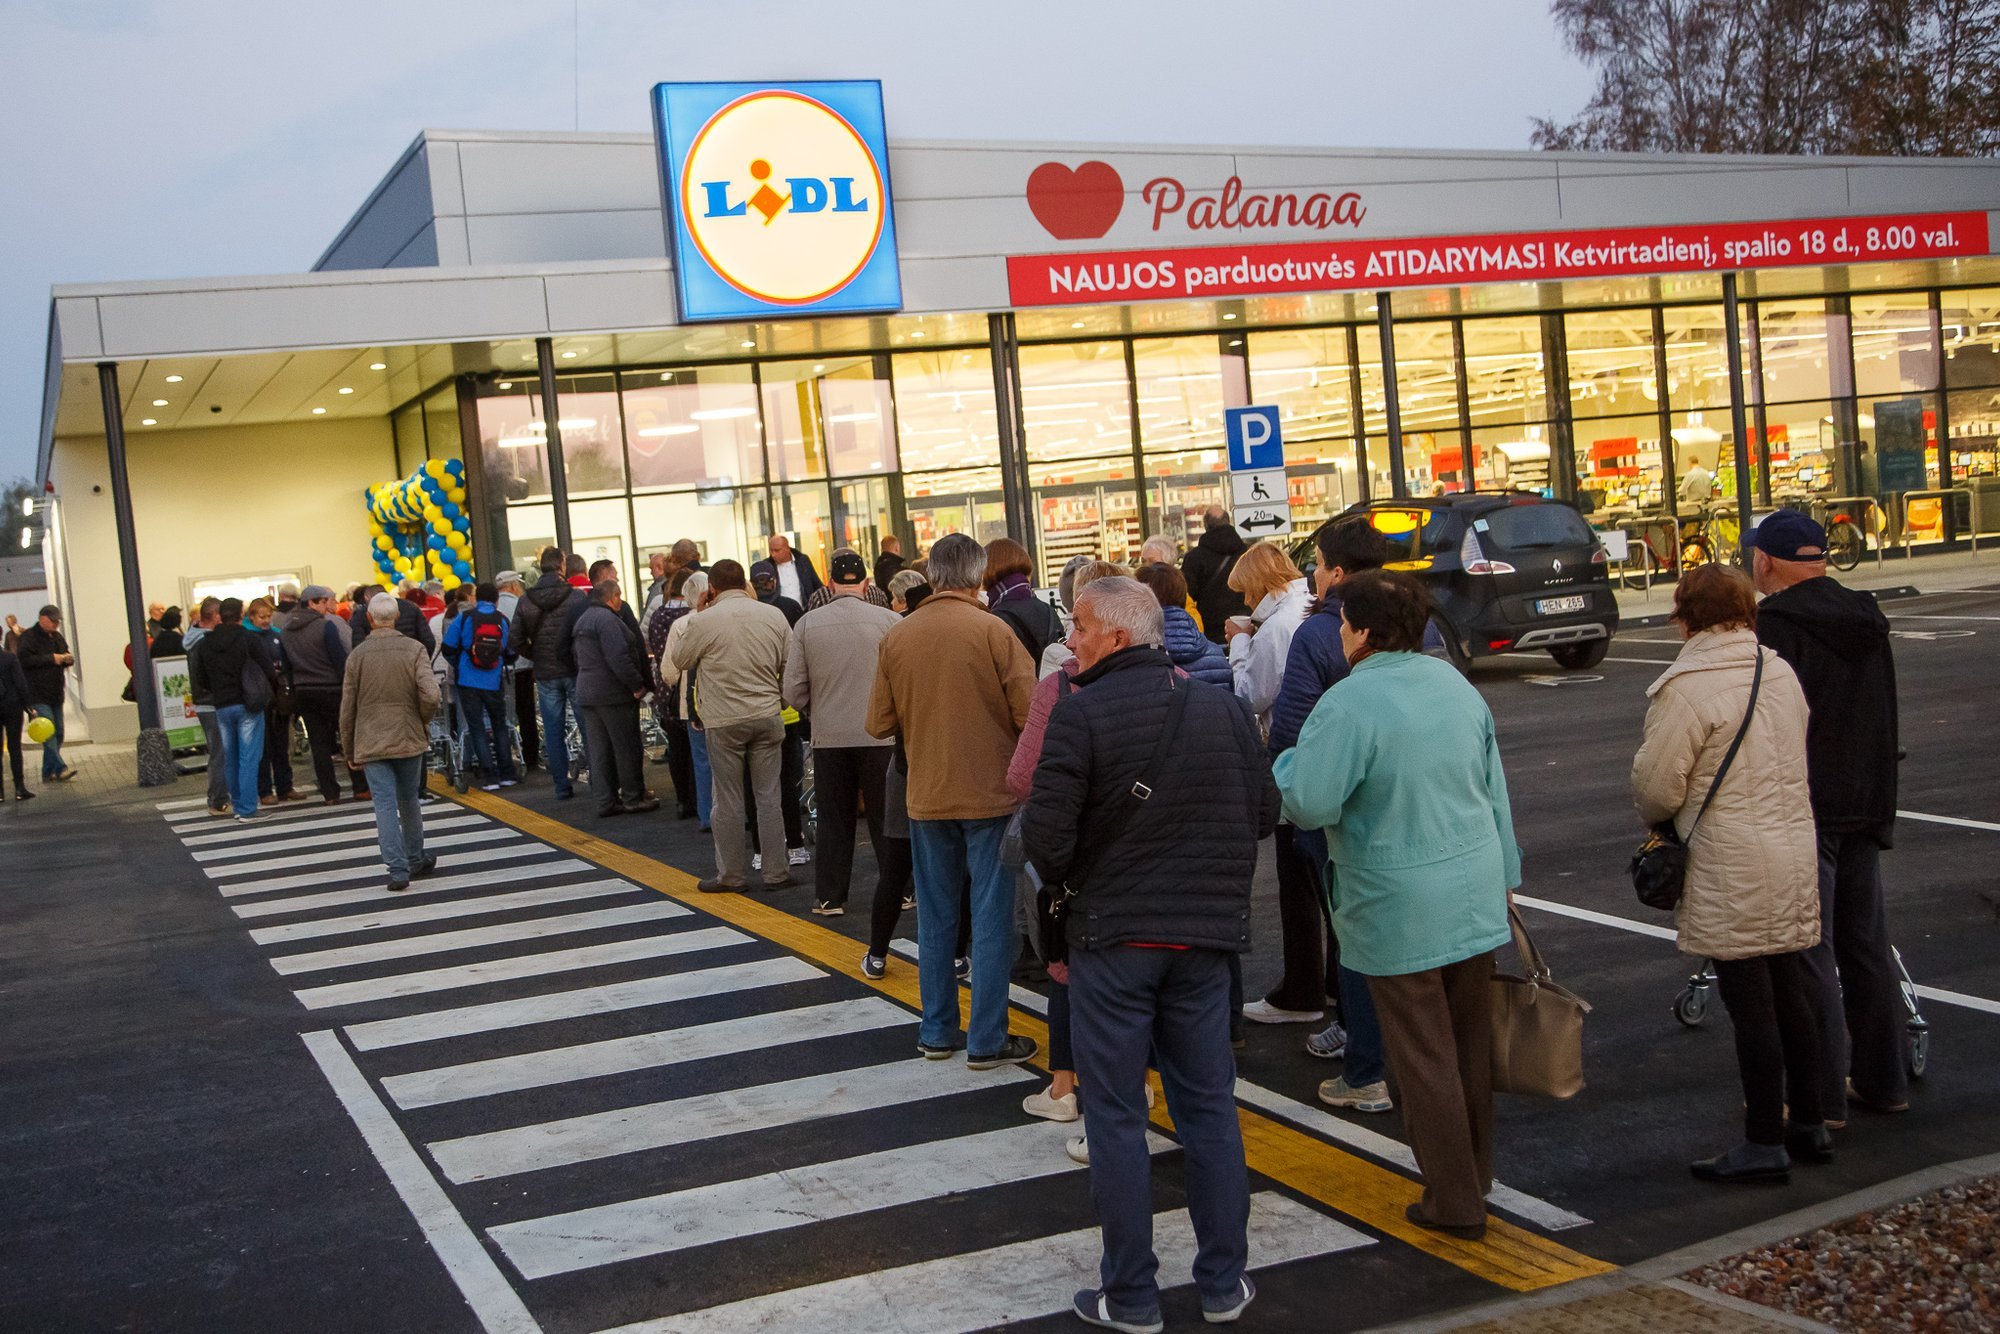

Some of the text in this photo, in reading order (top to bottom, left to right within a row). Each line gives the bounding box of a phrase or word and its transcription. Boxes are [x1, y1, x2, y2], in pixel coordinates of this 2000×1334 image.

[1049, 223, 1959, 294] NAUJOS parduotuvės ATIDARYMAS! Ketvirtadienį, spalio 18 d., 8.00 val.
[1240, 413, 1271, 464] P
[1541, 599, 1562, 613] HEN
